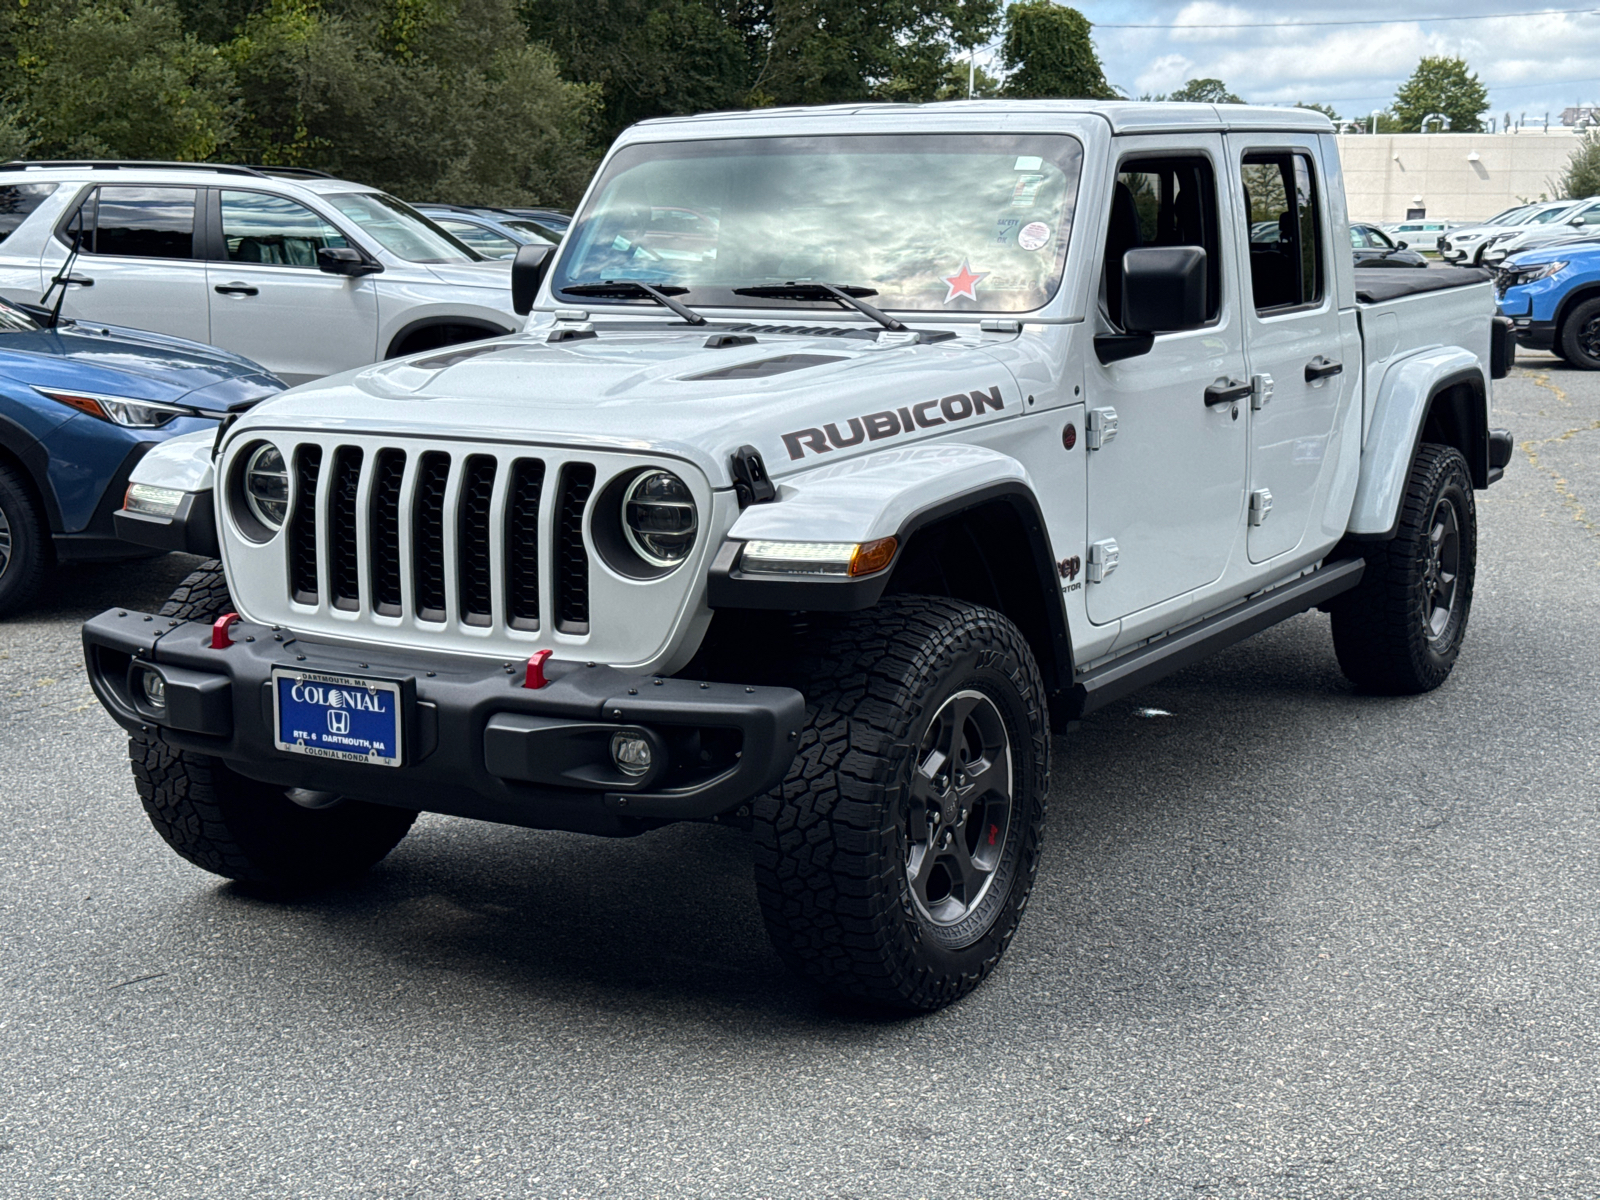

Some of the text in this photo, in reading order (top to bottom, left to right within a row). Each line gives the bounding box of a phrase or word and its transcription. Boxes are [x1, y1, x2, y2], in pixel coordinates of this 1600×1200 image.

[780, 385, 1005, 461] RUBICON
[354, 679, 367, 687] MA
[291, 684, 386, 713] COLONIAL
[293, 730, 310, 740] RTE.
[322, 734, 372, 749] DARTMOUTH,
[373, 741, 385, 750] MA
[304, 747, 369, 763] COLONIAL HONDA
